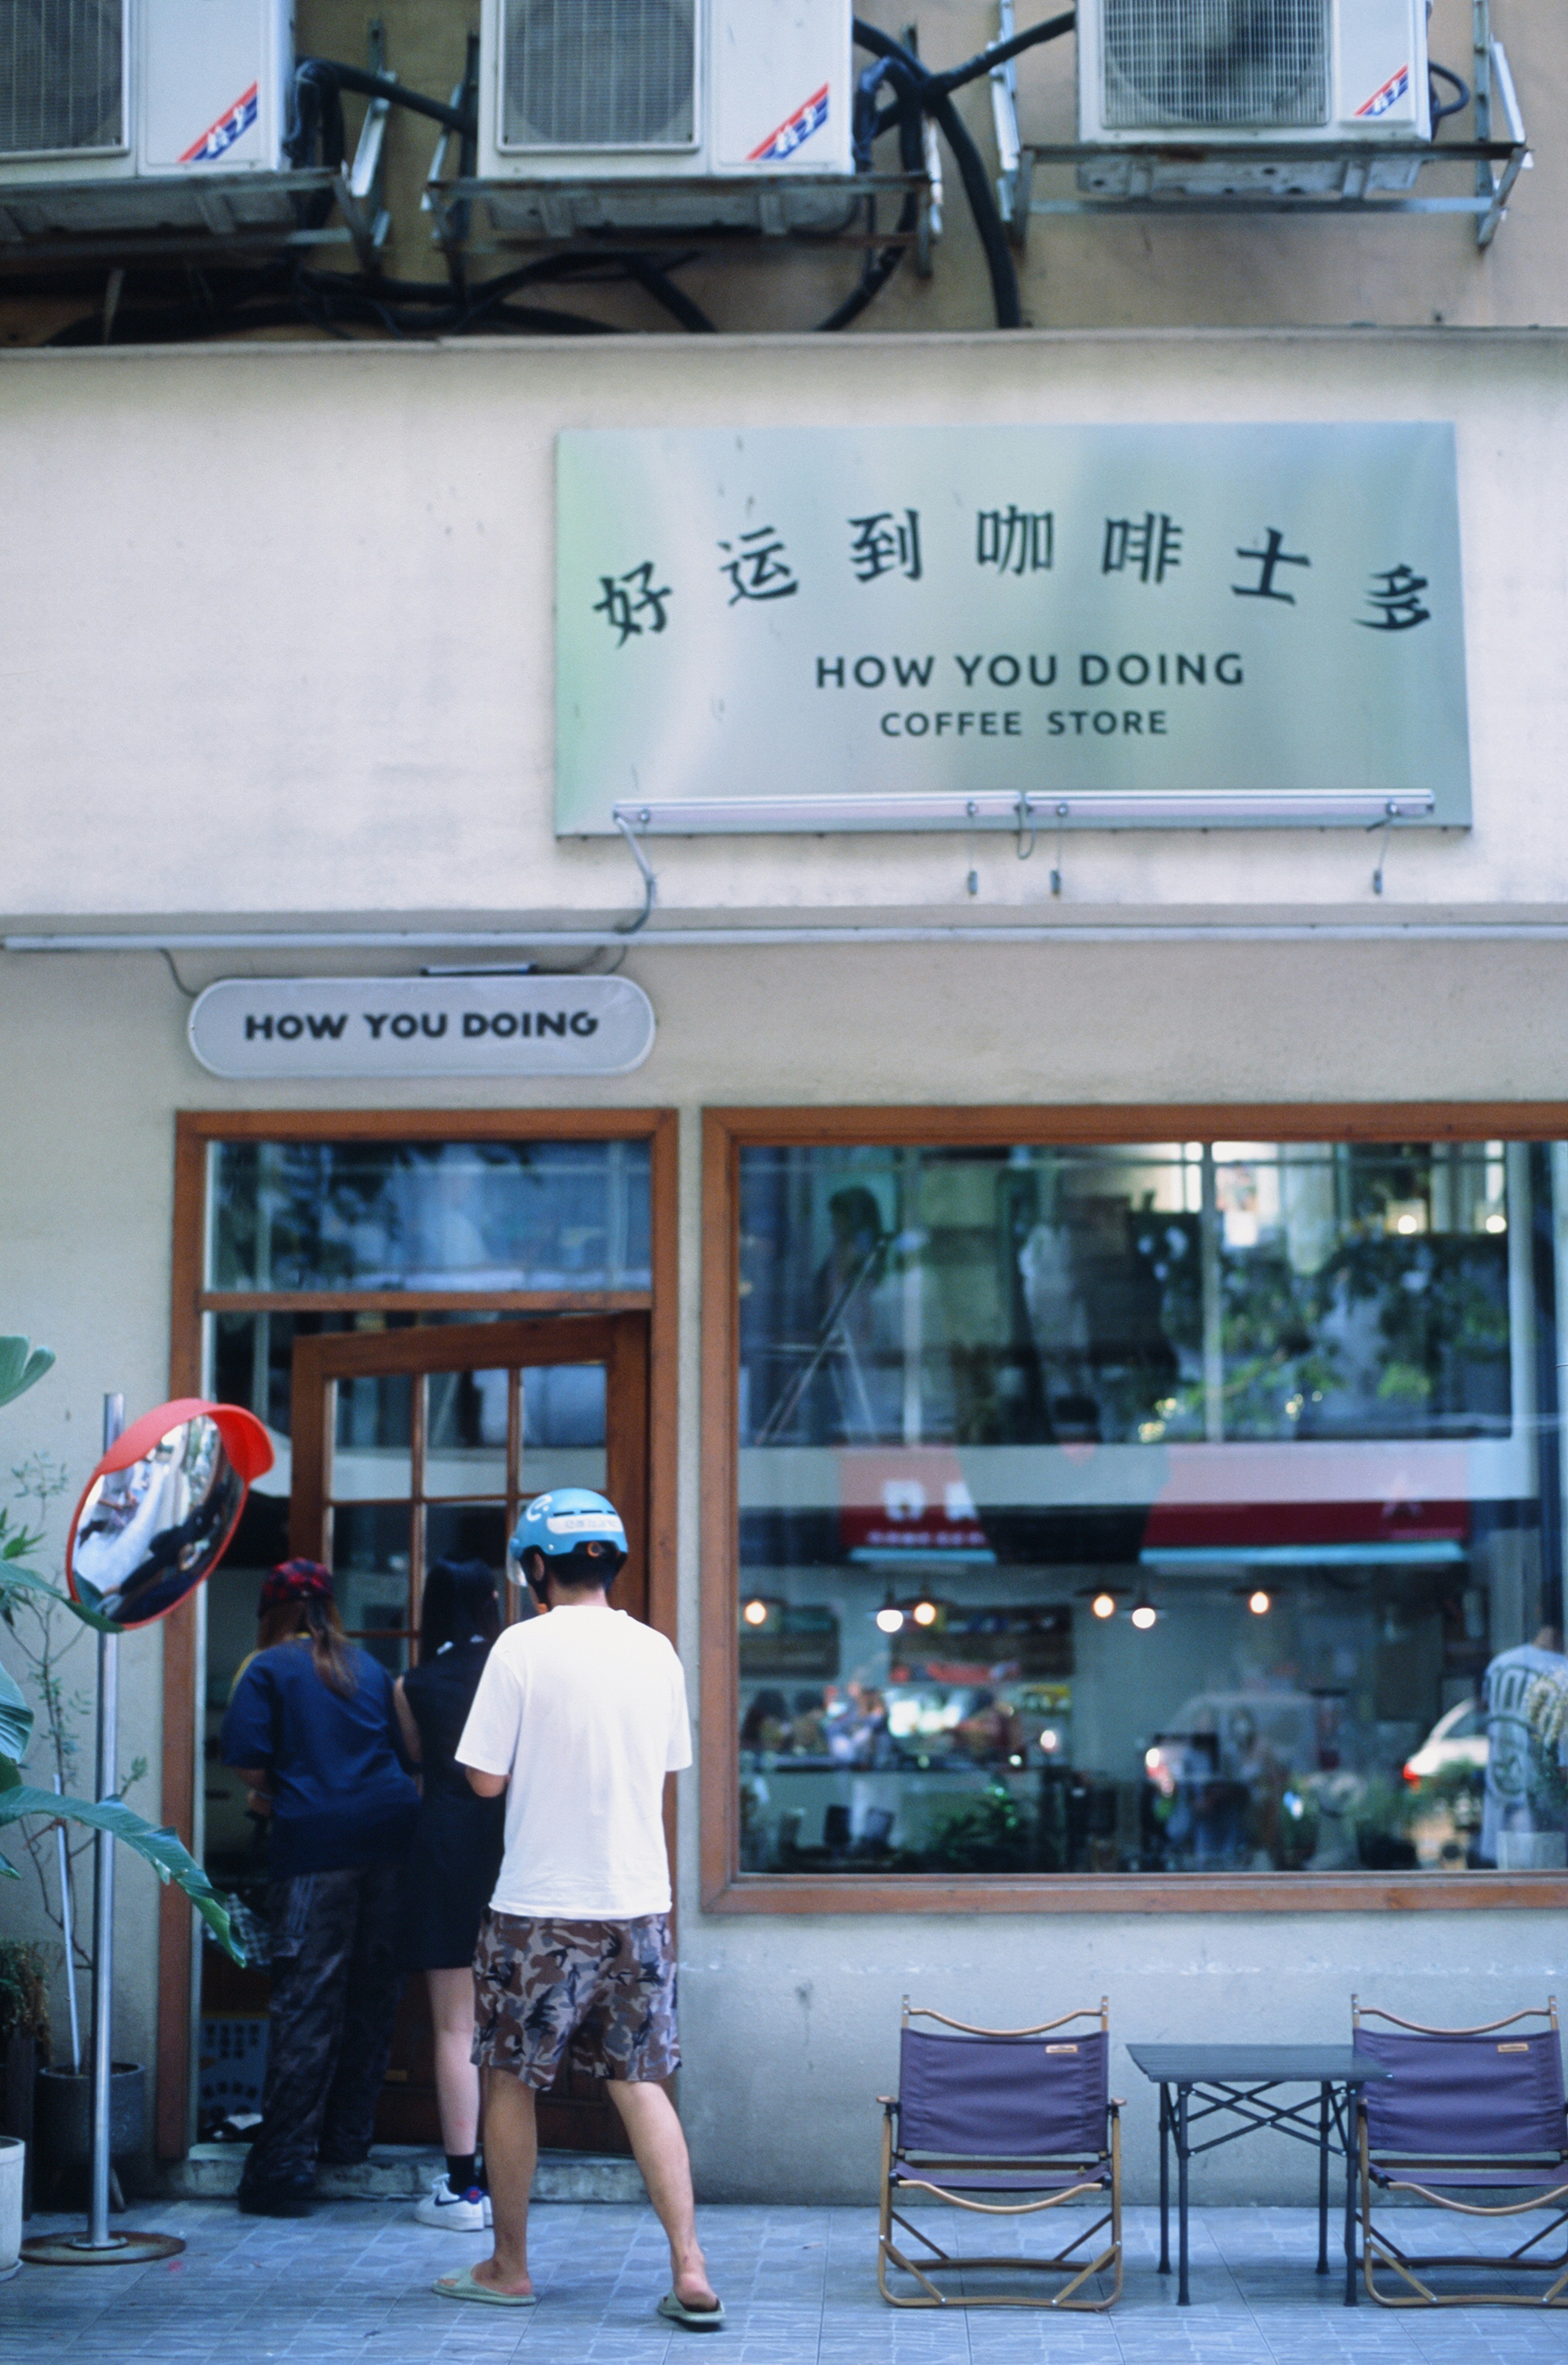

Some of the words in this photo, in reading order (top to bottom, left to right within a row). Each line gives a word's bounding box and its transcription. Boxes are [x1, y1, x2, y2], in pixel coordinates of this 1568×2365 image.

[592, 504, 1431, 647] 好运到咖啡士多
[815, 654, 935, 689] HOW
[954, 653, 1058, 688] YOU
[1079, 652, 1244, 687] DOING
[880, 711, 1021, 738] COFFEE
[1047, 710, 1166, 736] STORE
[244, 1013, 348, 1041] HOW
[363, 1012, 448, 1040] YOU
[461, 1010, 599, 1039] DOING
